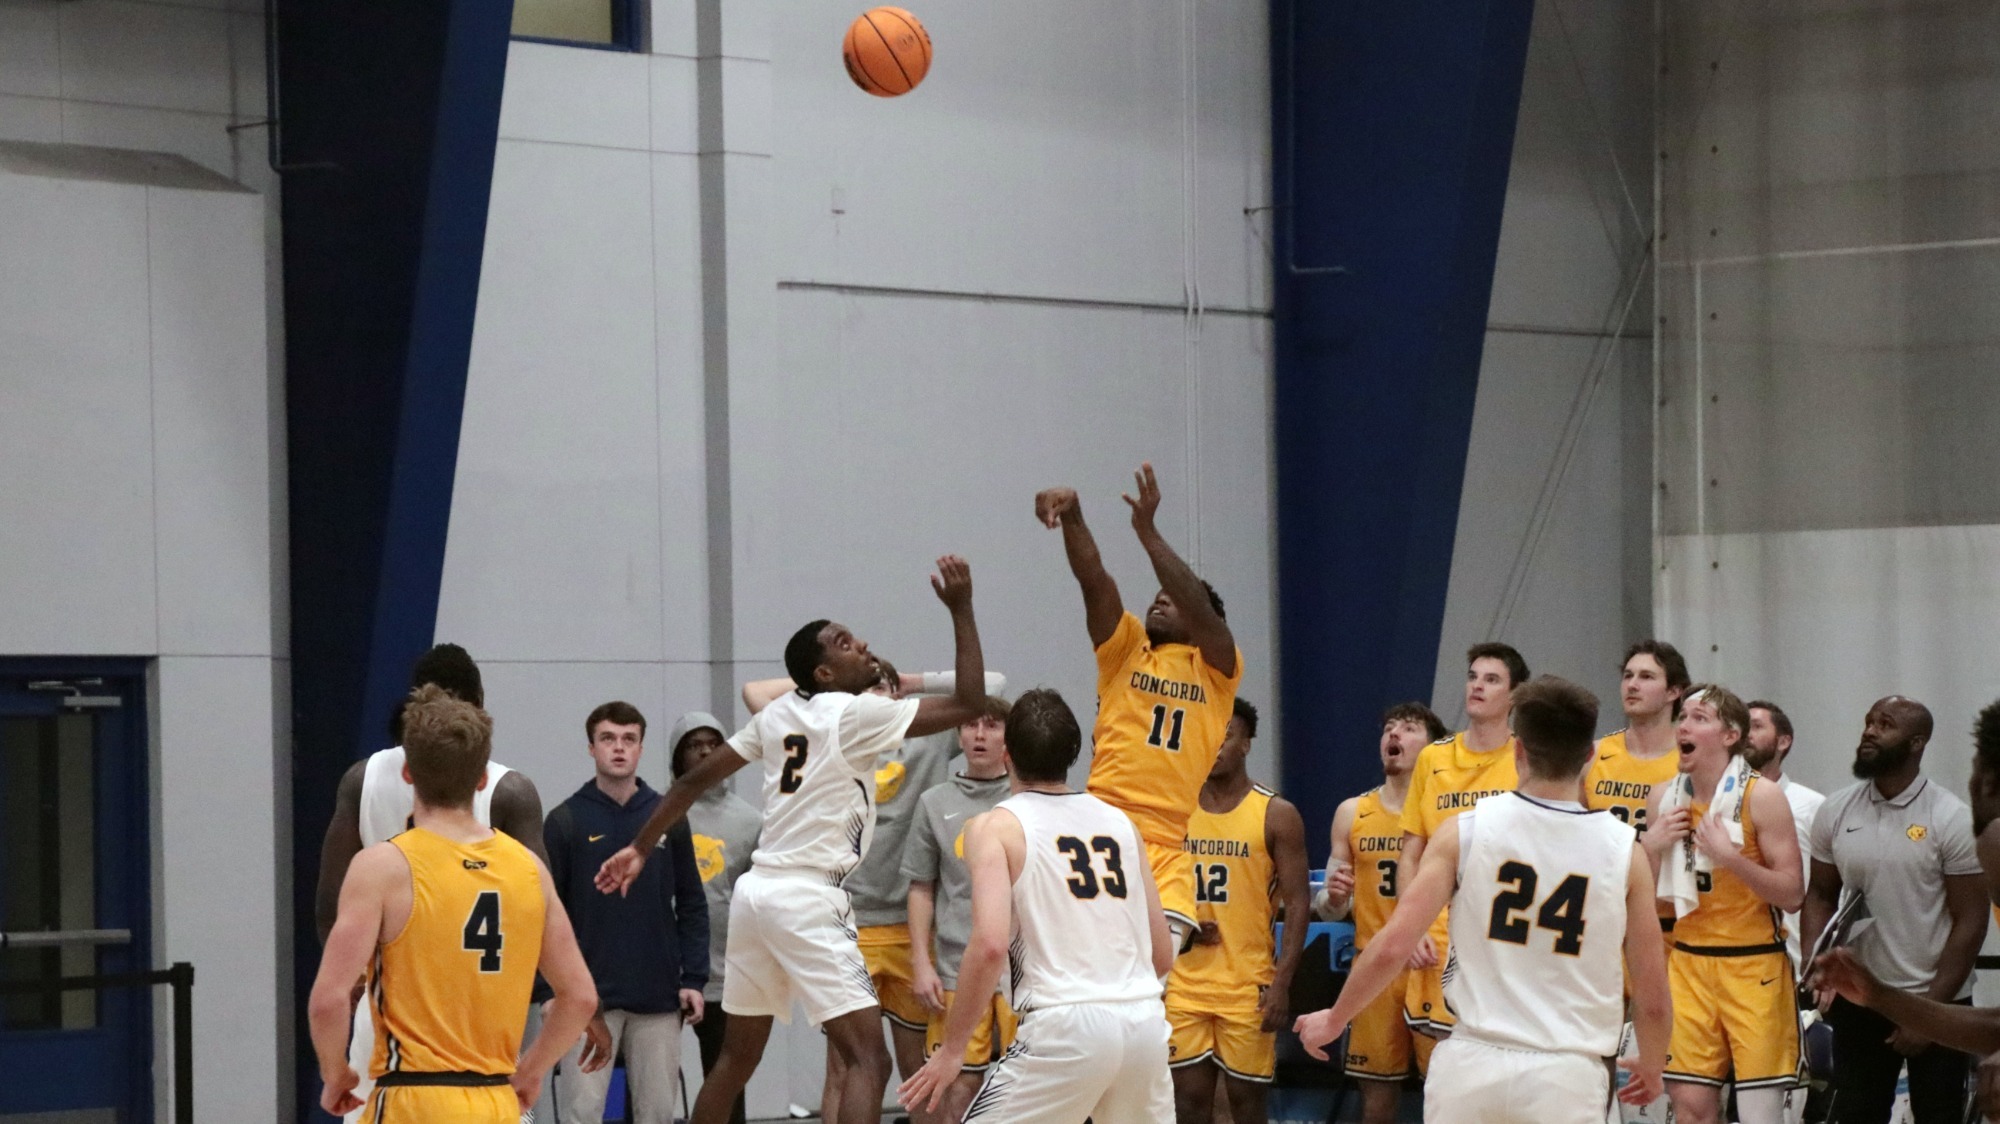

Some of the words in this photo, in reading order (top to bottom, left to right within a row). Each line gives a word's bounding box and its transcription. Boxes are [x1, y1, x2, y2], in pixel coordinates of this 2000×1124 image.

[1146, 703, 1185, 752] 11
[780, 732, 809, 794] 2
[1056, 835, 1128, 900] 33
[1194, 863, 1228, 904] 12
[1377, 859, 1398, 898] 3
[462, 890, 504, 973] 4
[1487, 859, 1590, 958] 24
